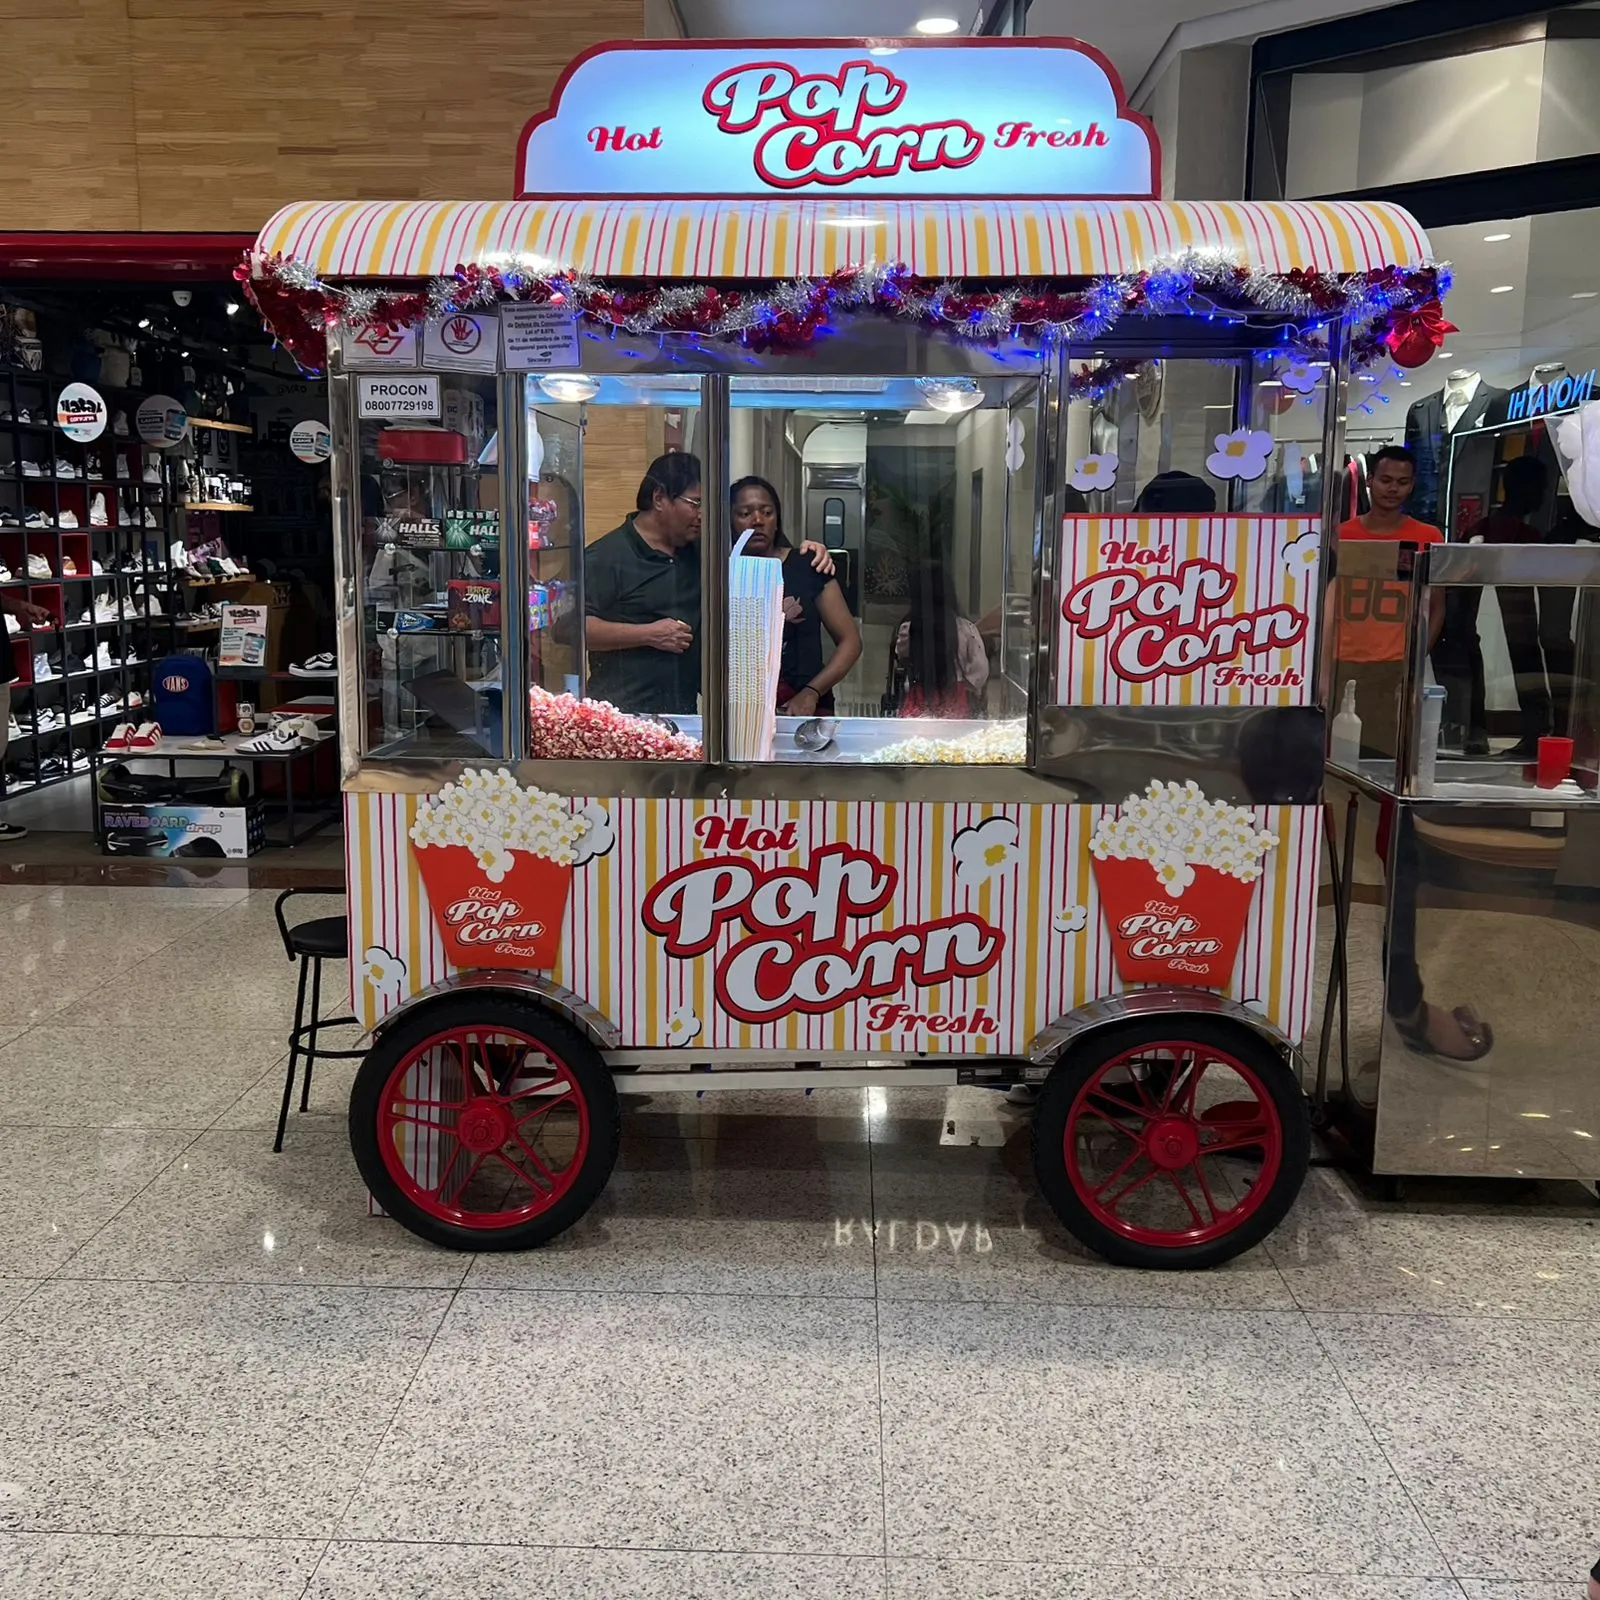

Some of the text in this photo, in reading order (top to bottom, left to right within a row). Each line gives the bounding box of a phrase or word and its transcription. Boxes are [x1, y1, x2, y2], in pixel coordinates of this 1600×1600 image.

[704, 59, 907, 136] Pop
[587, 126, 663, 151] Hot
[994, 121, 1111, 149] Fresh
[754, 121, 985, 189] Corn
[370, 384, 428, 396] PROCON
[364, 400, 434, 411] 08007729198
[399, 522, 440, 534] HALLS
[1100, 541, 1172, 564] Hot
[462, 594, 493, 605] ZONE
[1062, 558, 1238, 639] Pop
[1110, 604, 1309, 683] Corn
[165, 676, 187, 692] VANS
[1212, 666, 1303, 687] Fresh
[185, 822, 222, 834] drop
[695, 815, 799, 851] Hot
[468, 886, 501, 901] Hot
[642, 843, 898, 958] Pop
[444, 898, 524, 925] Pop
[1145, 900, 1179, 915] Hot
[456, 920, 546, 946] Corn
[1117, 913, 1201, 941] Pop
[495, 942, 536, 958] Fresh
[1128, 936, 1223, 961] Corn
[715, 912, 1005, 1025] Corn
[1168, 958, 1210, 974] Fresh
[866, 1003, 999, 1035] Fresh
